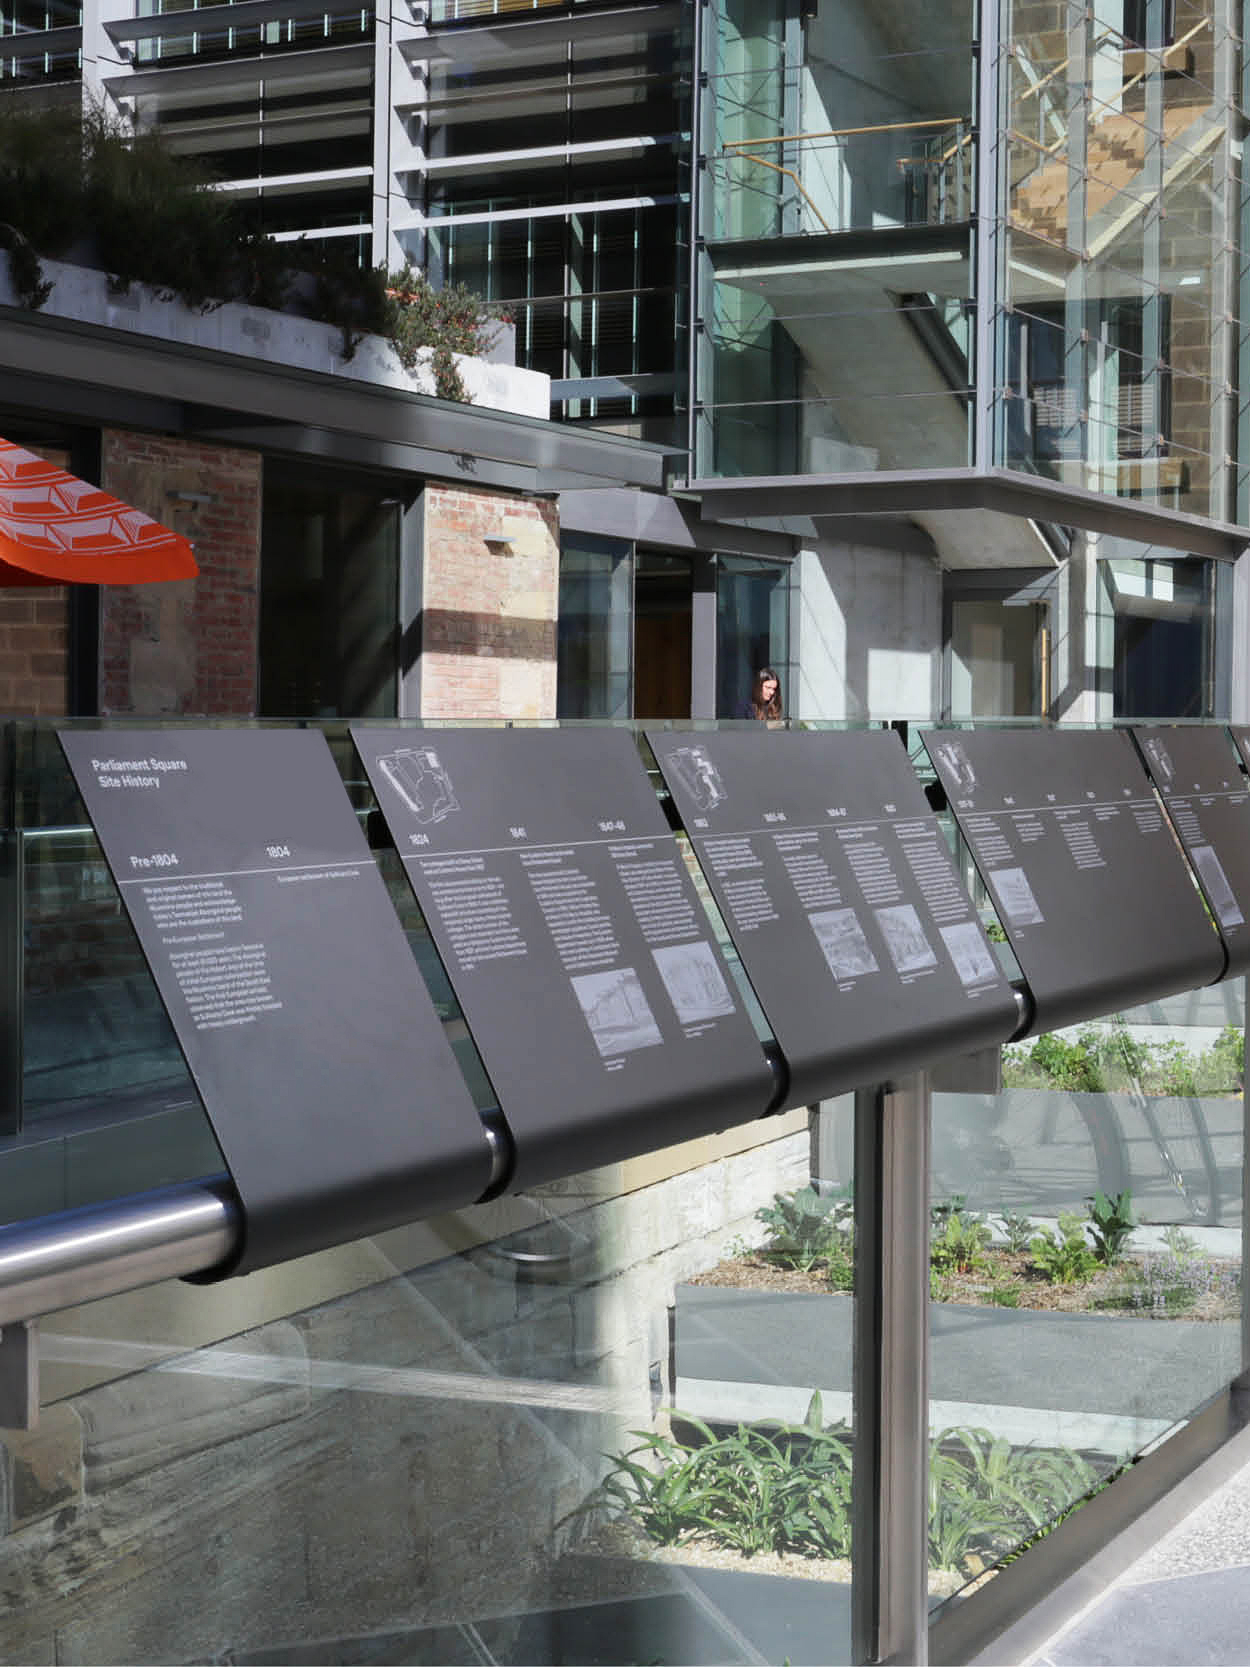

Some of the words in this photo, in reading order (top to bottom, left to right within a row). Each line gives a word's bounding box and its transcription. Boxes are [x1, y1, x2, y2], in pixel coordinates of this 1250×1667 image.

[91, 759, 151, 772] Parliament
[150, 758, 188, 773] Square
[98, 775, 121, 788] Site
[121, 774, 160, 789] History
[266, 845, 291, 858] 1804
[130, 853, 179, 869] Pre-1804
